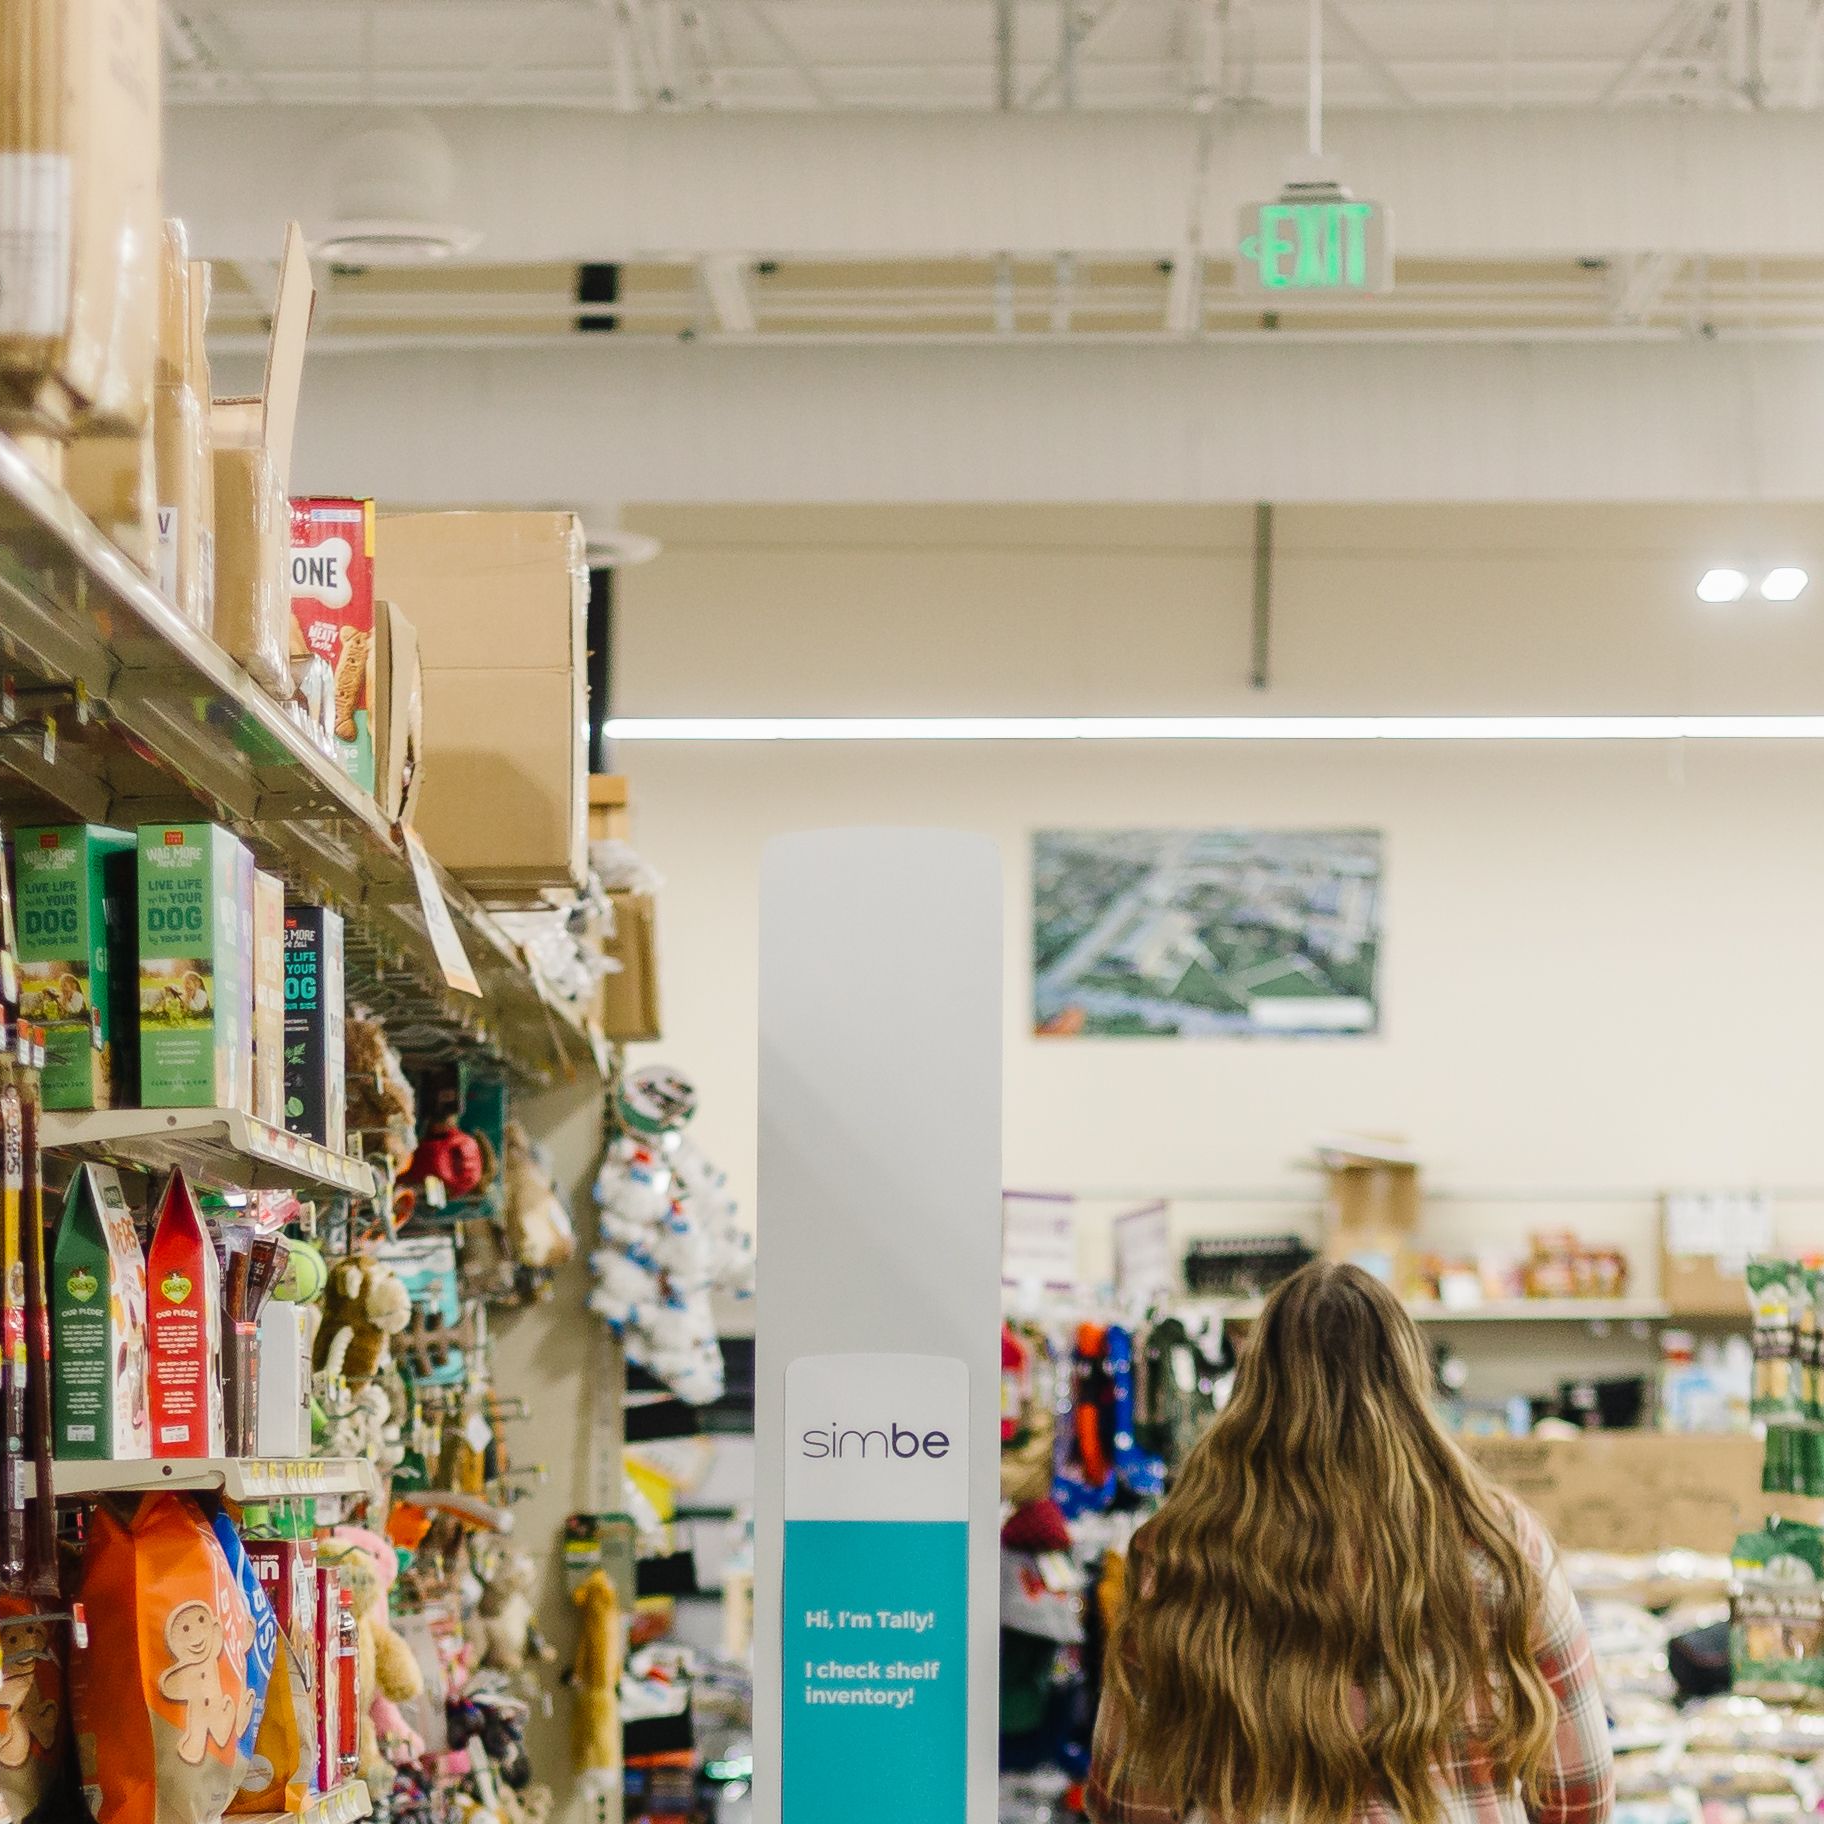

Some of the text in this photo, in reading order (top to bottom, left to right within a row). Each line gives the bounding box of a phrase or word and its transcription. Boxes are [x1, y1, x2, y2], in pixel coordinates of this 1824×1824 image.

[1260, 204, 1372, 288] EXIT
[292, 557, 337, 588] ONE
[25, 880, 77, 894] LIVE LIFE
[148, 879, 203, 891] LIVE LIFE
[47, 894, 77, 906] YOUR
[170, 892, 202, 903] YOUR
[25, 908, 78, 934] DOG
[147, 906, 203, 931] DOG
[291, 929, 316, 942] MORE
[293, 951, 317, 962] LIFE
[286, 964, 317, 974] YOUR
[284, 977, 317, 1000] OG
[803, 1422, 951, 1459] simbe
[805, 1610, 934, 1633] Hi, I'm Tally!
[805, 1661, 940, 1679] I check shelf
[805, 1686, 915, 1709] inventory!
